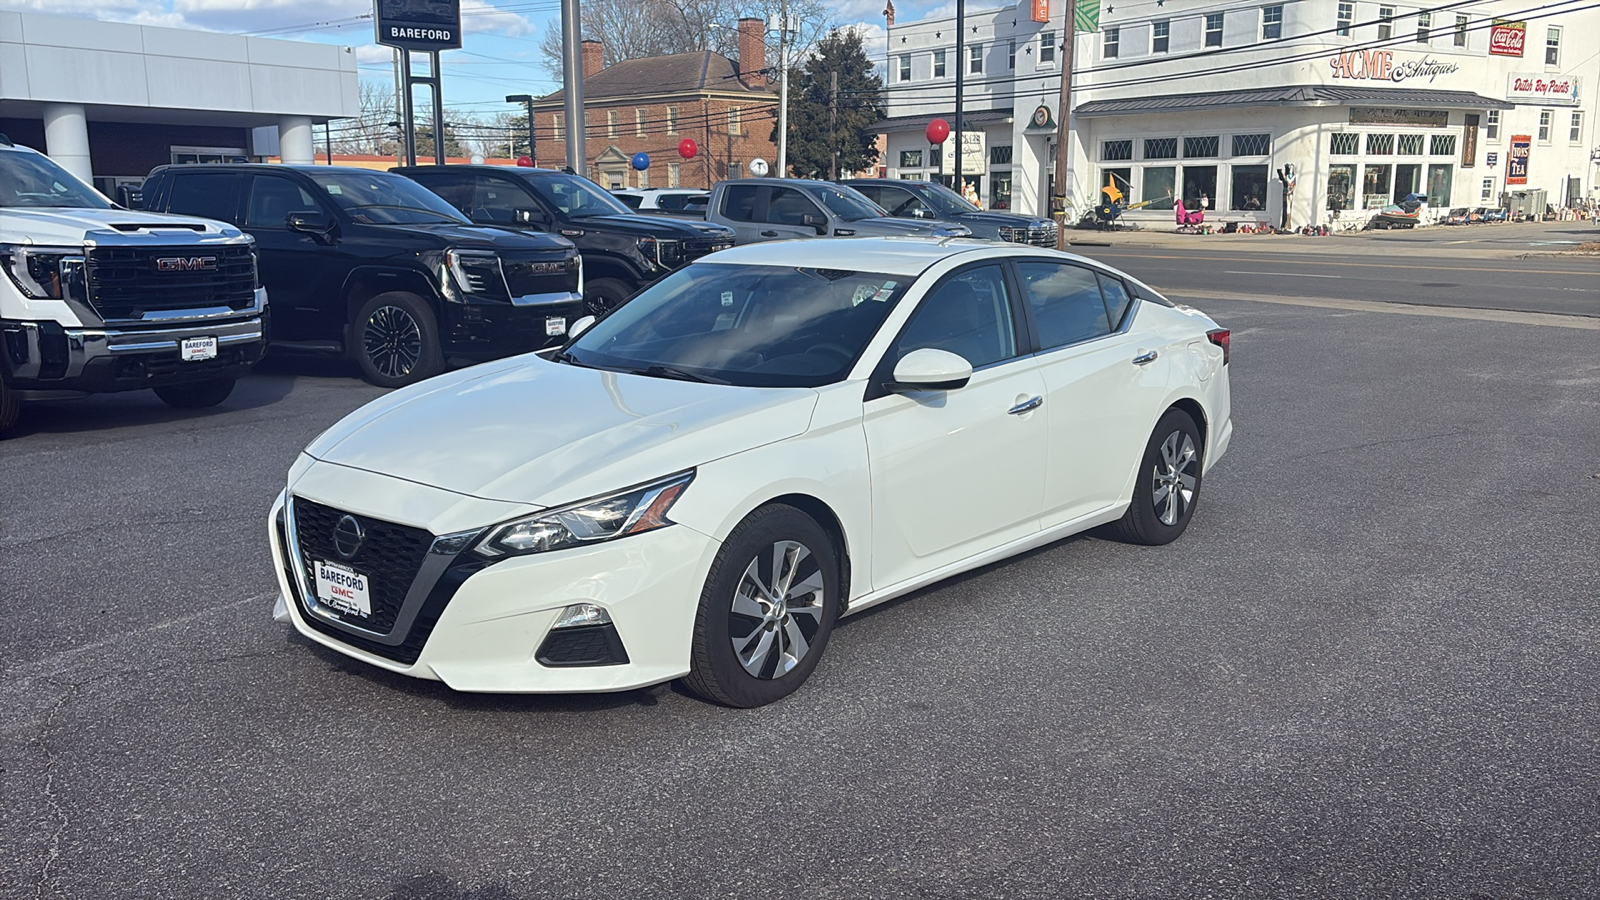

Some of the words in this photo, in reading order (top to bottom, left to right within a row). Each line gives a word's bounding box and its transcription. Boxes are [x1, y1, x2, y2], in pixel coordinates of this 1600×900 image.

[391, 27, 451, 41] BAREFORD
[1330, 48, 1393, 81] ACME
[1514, 78, 1533, 92] Dutch
[1535, 79, 1548, 95] Boy
[1548, 80, 1569, 94] Paints
[1512, 163, 1526, 175] TEA
[157, 257, 217, 271] GMC
[532, 262, 565, 273] GMC
[185, 341, 213, 349] BAREFORD
[320, 567, 364, 591] BAREFORD
[331, 585, 354, 600] GMC
